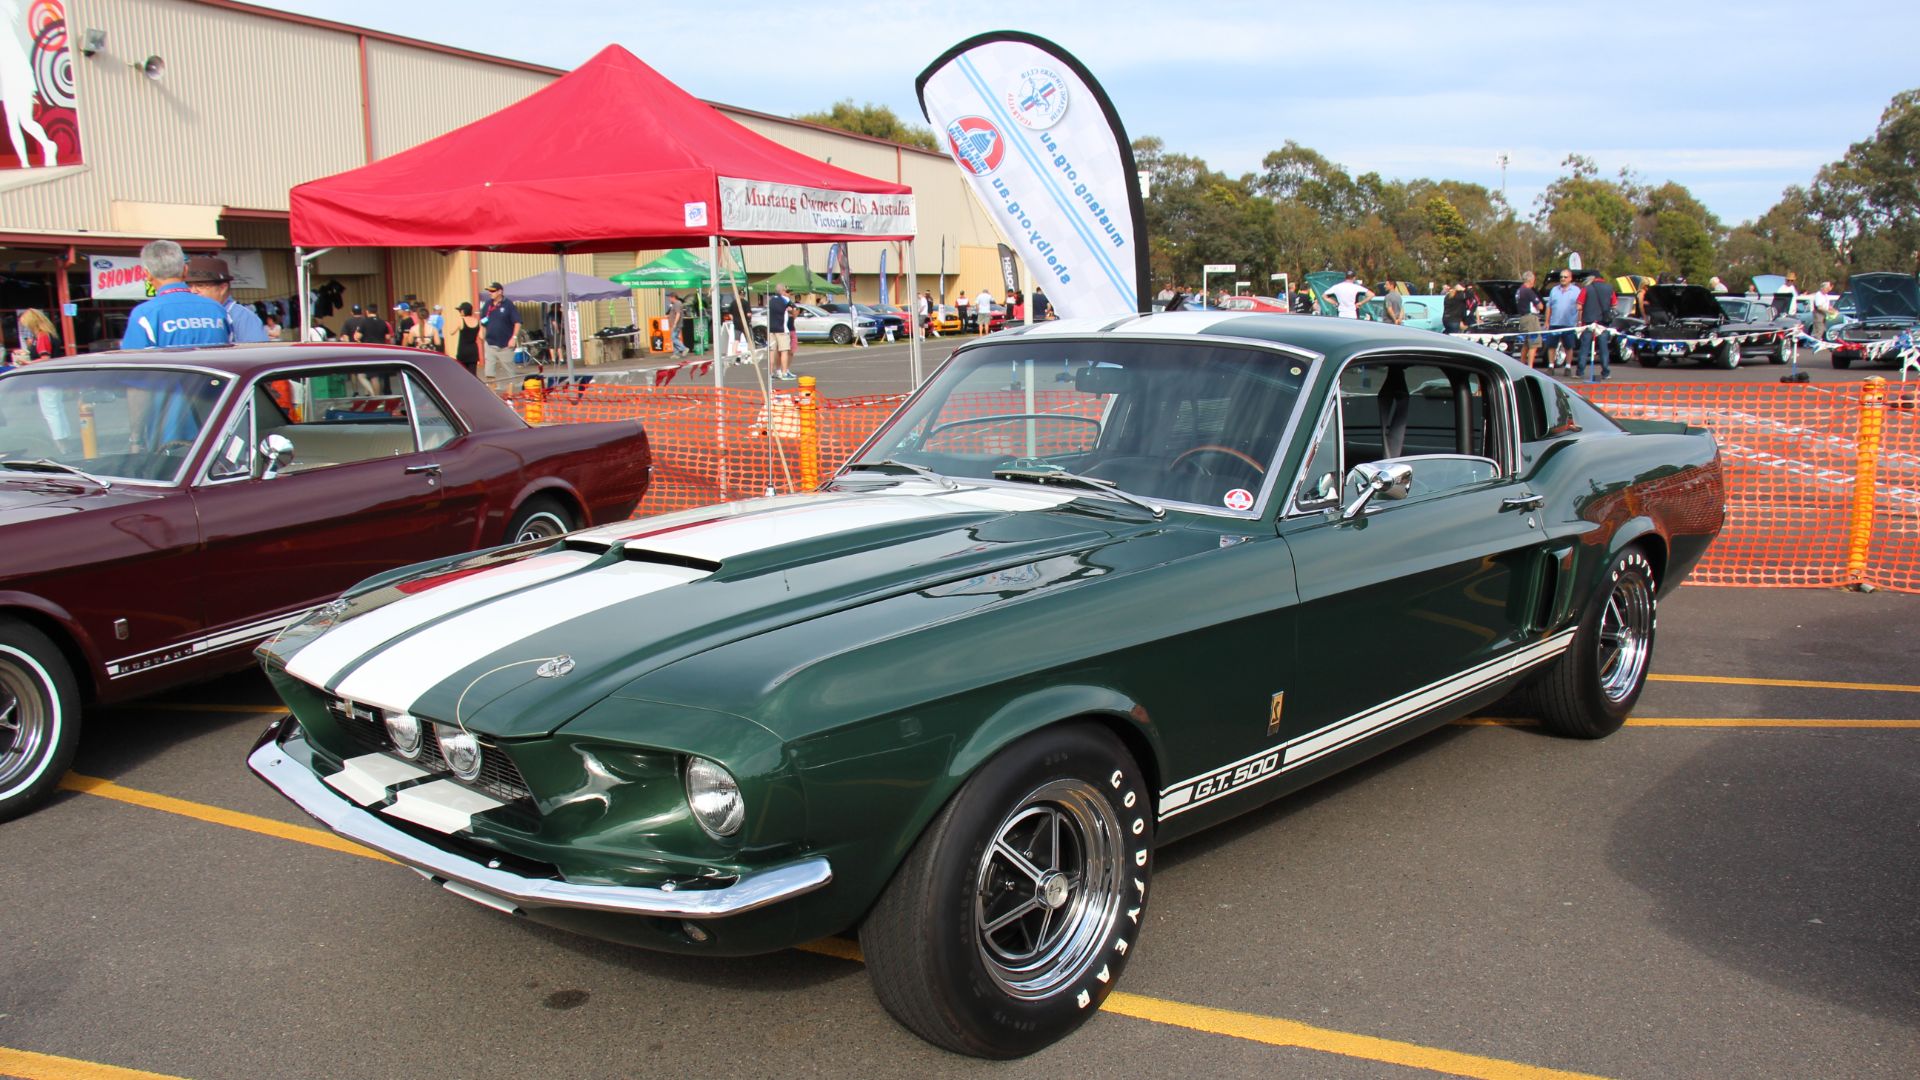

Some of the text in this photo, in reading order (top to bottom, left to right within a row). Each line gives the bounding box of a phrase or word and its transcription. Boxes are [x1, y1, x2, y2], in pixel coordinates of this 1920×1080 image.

[745, 187, 797, 214] Mustang
[801, 192, 838, 213] Owners
[812, 213, 847, 228] Victoria
[98, 265, 146, 289] SHOWB
[162, 317, 224, 334] COBRA
[1076, 769, 1147, 1009] GOODYEAR
